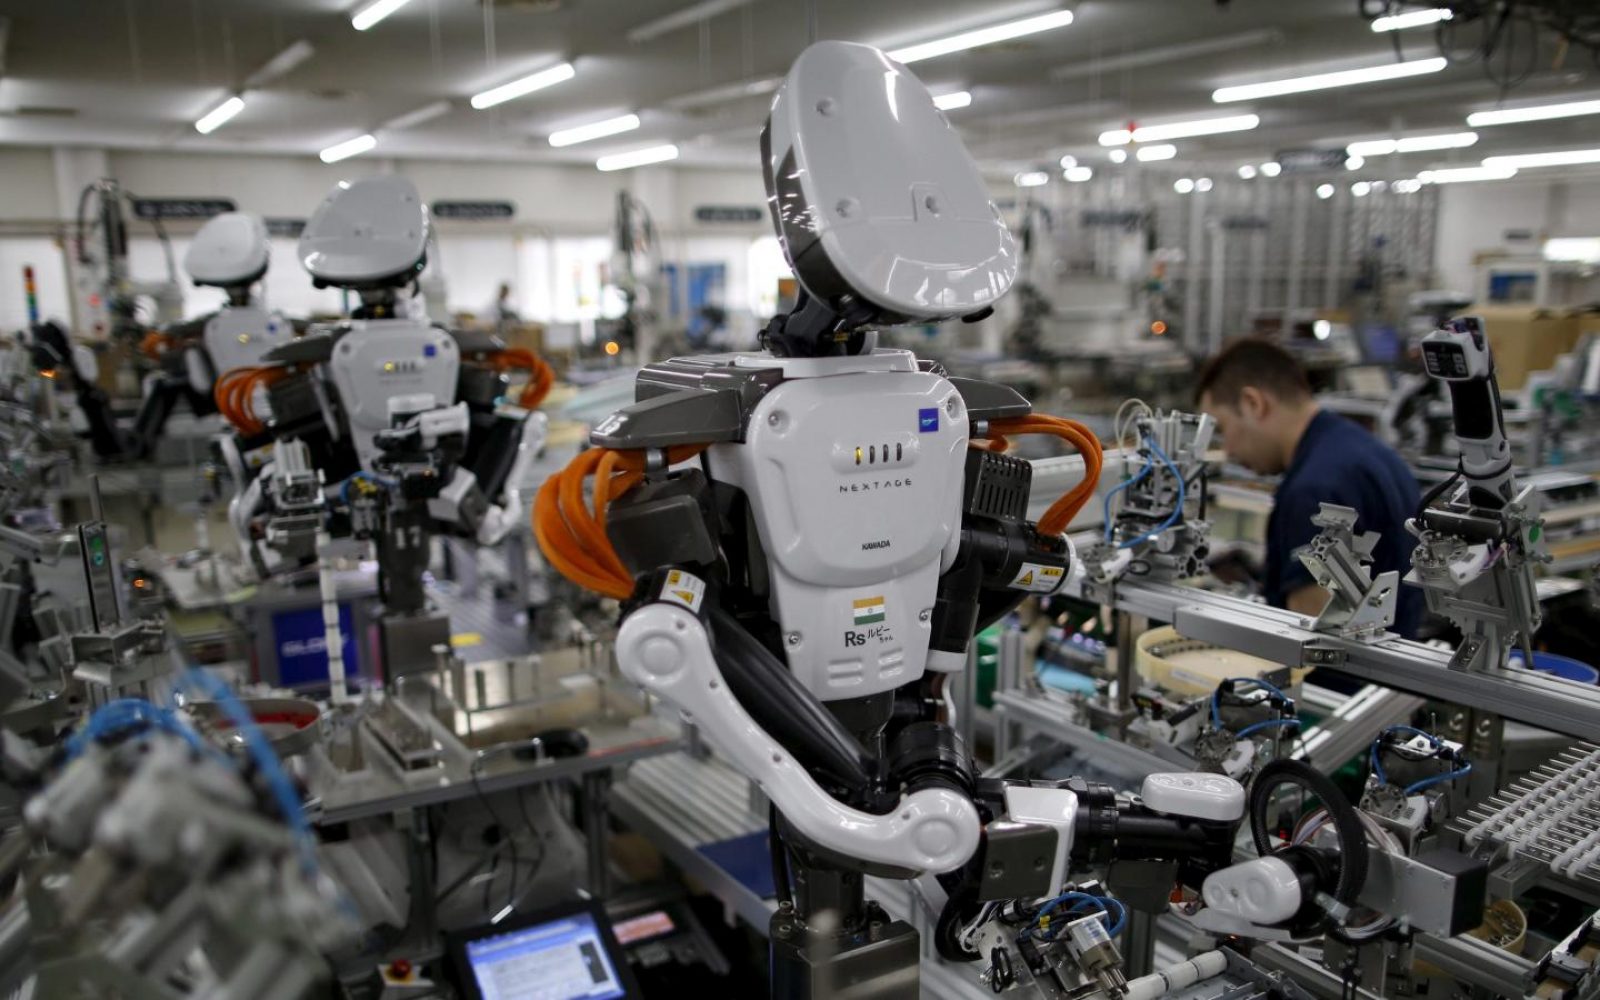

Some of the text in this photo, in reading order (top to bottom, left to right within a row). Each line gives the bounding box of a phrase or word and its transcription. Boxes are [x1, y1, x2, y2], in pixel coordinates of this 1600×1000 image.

[839, 478, 912, 493] NEXTAGE
[862, 539, 891, 550] KAWADA
[845, 631, 866, 647] Rs
